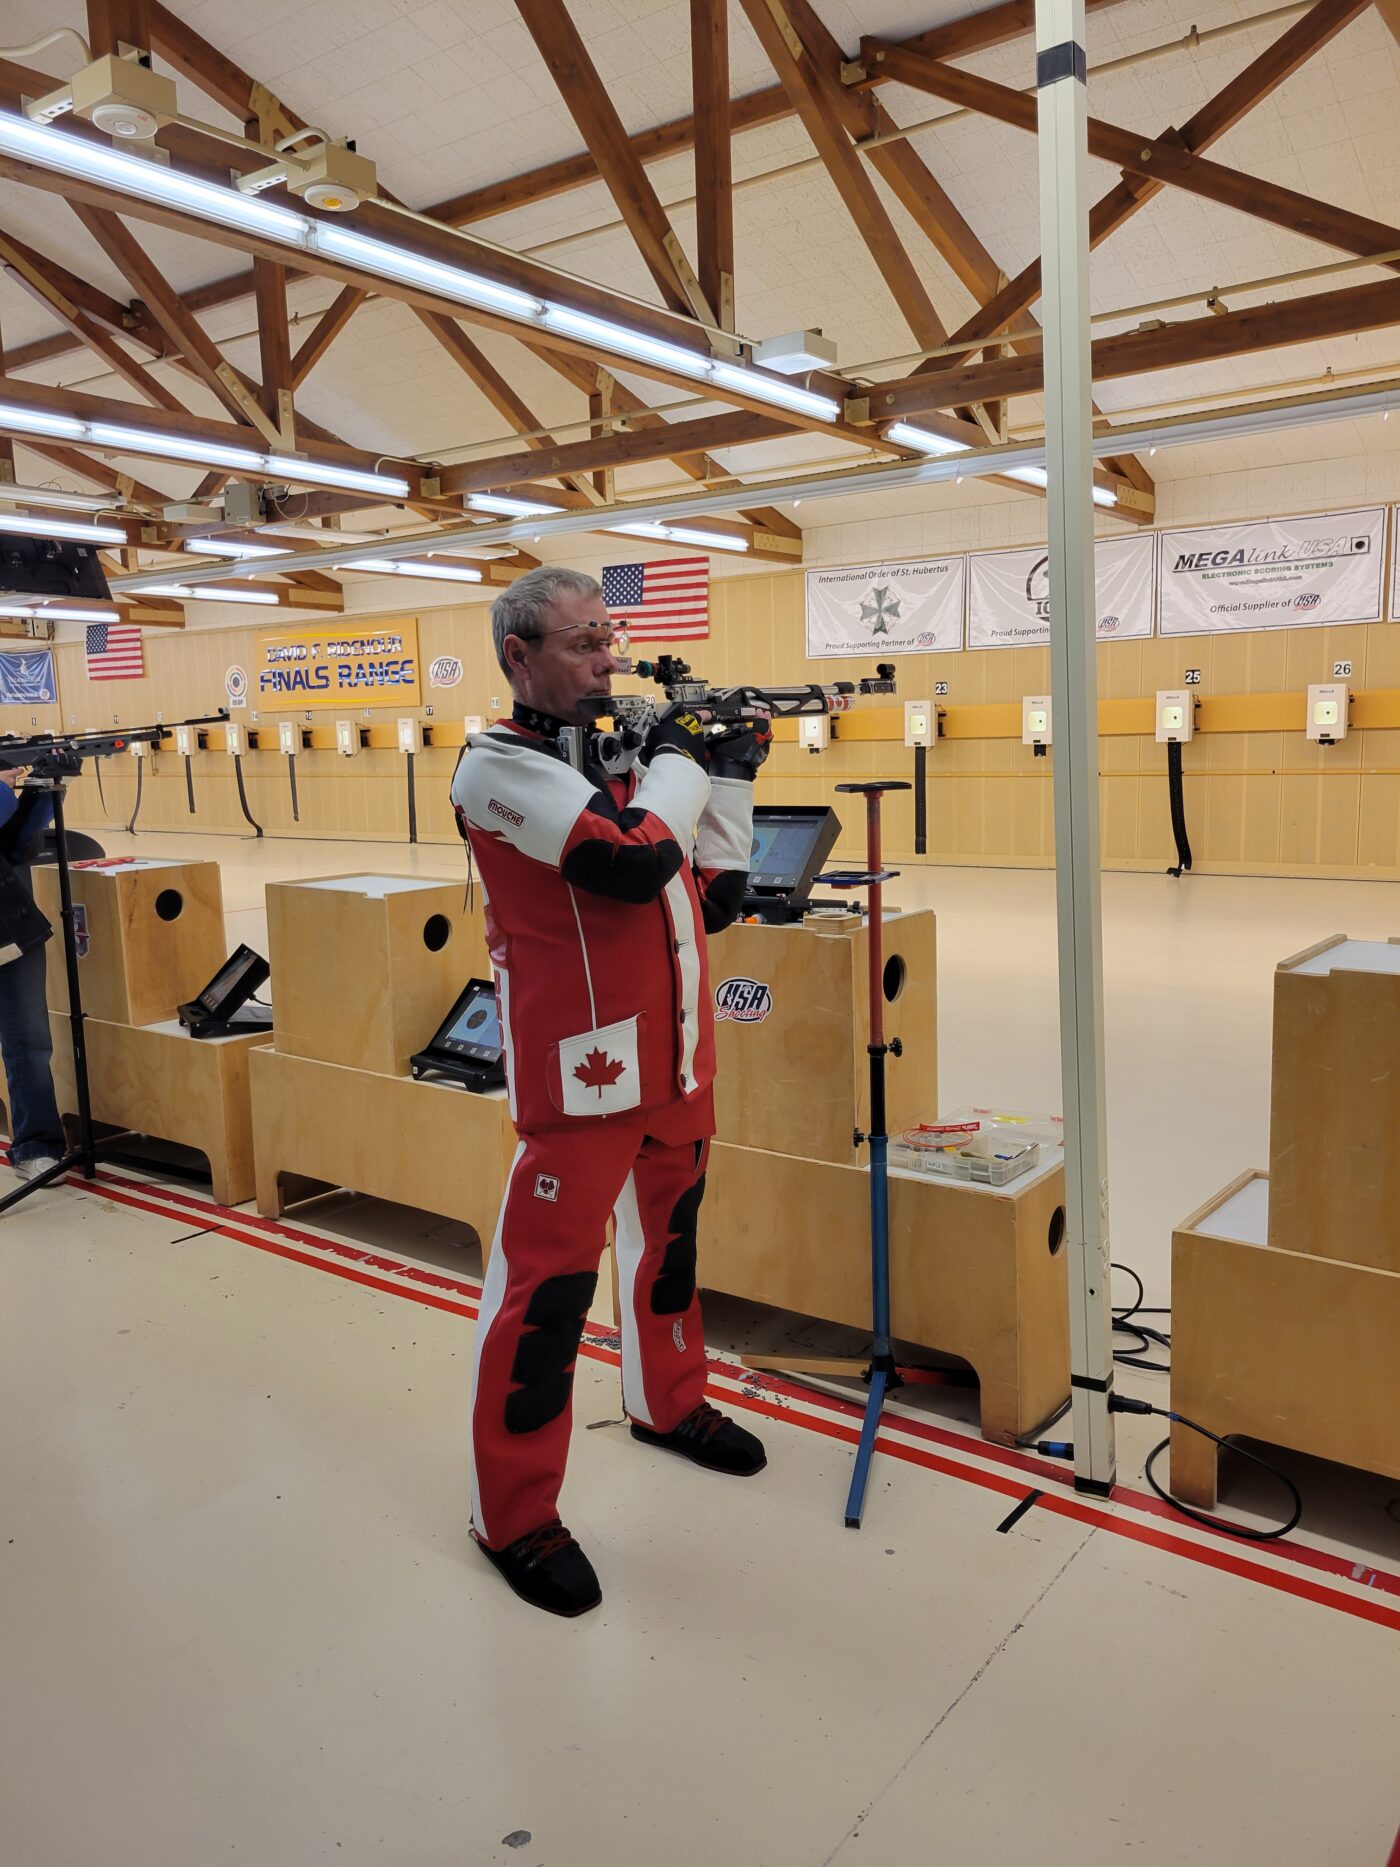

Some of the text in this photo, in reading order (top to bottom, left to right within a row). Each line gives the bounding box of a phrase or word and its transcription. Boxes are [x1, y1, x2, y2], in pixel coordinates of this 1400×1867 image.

[818, 565, 949, 583] International Order of St. Hubertus
[1202, 561, 1334, 579] ELECTRONIC SCORING SYSTEMS
[1210, 603, 1241, 613] Official
[1242, 600, 1279, 611] Supplier
[1281, 598, 1292, 608] of
[1297, 594, 1320, 606] USA
[991, 626, 1049, 637] Proud Supportin
[267, 636, 402, 663] DAVID F. RIDENOUR
[846, 639, 880, 649] Supporting
[881, 639, 905, 647] Partner
[906, 638, 915, 646] of
[260, 659, 415, 691] FINALS RANGE
[435, 661, 459, 679] USA
[1185, 671, 1200, 683] 25
[1334, 664, 1351, 676] 26
[935, 683, 947, 693] 23
[646, 696, 656, 705] 20
[490, 802, 522, 825] MOUCHE
[721, 983, 768, 1011] USA
[715, 1005, 766, 1022] Shooting
